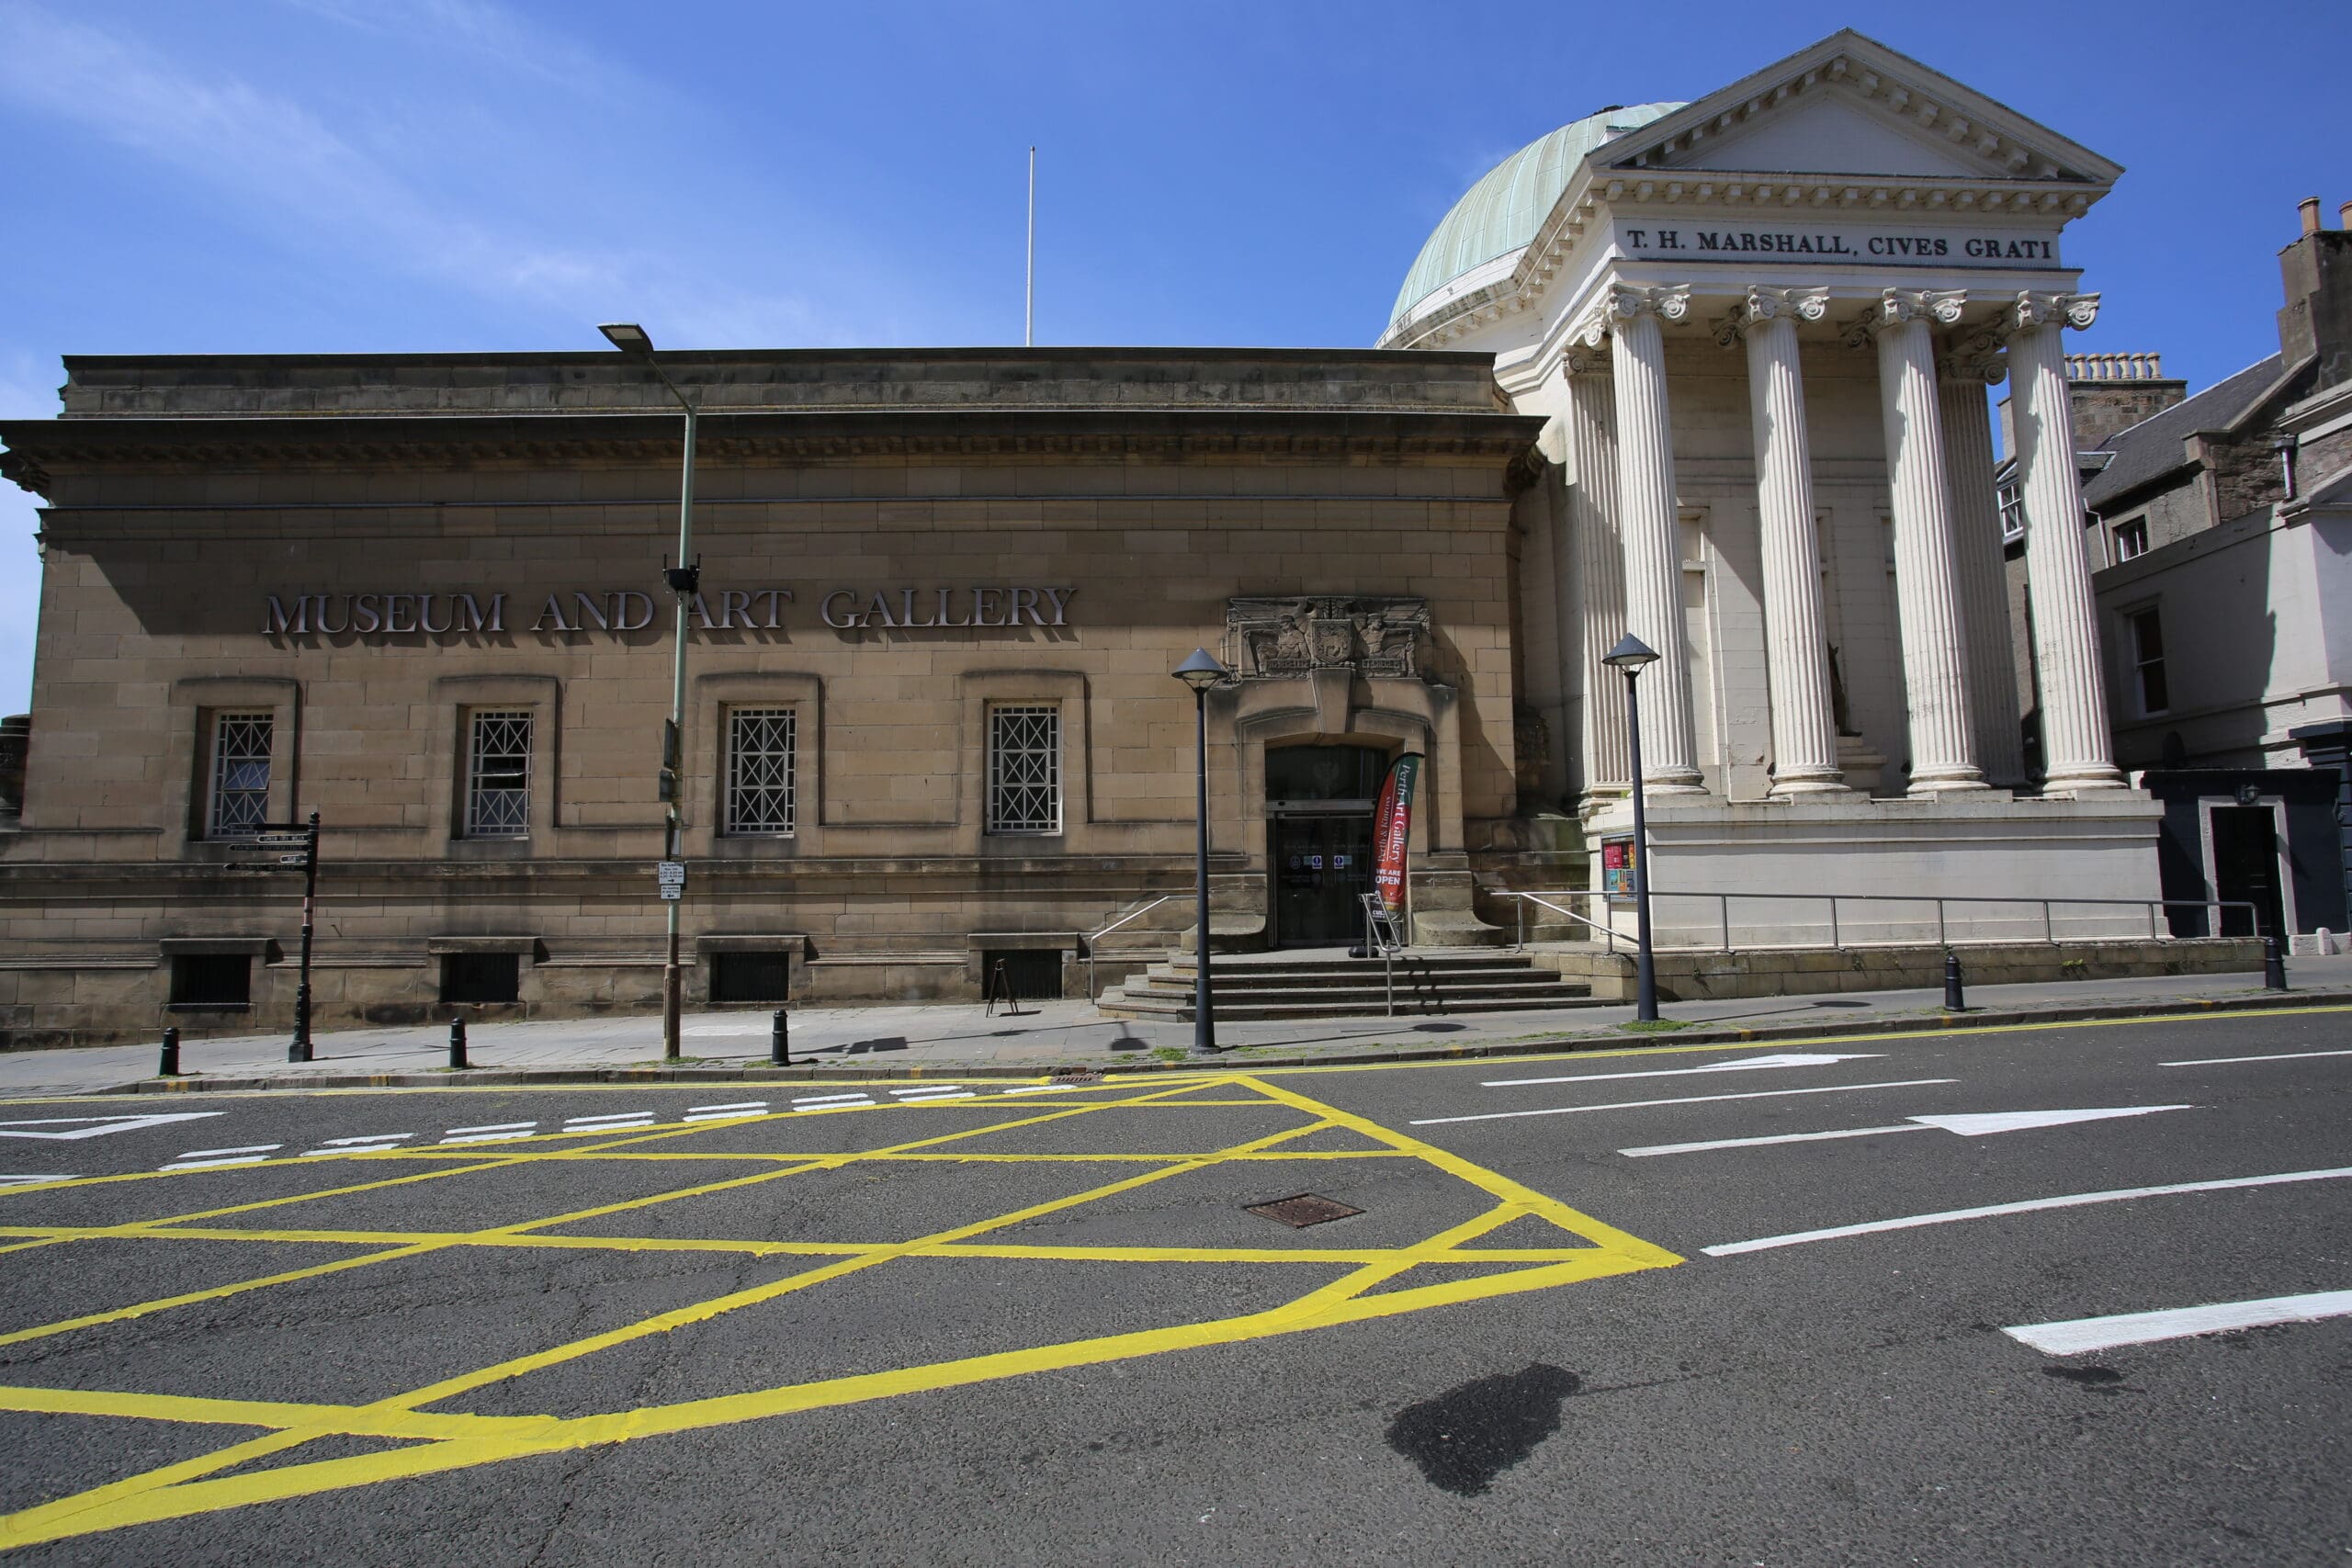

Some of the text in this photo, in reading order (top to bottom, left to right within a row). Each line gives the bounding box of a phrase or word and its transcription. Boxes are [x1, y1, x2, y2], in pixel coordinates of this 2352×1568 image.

[1626, 230, 2052, 259] T. H. MARSHALL, CIVES GRATI
[261, 587, 1079, 635] MUSEUM AND ART GALLERY
[1389, 764, 1410, 863] Perth Art Gallery
[1374, 874, 1401, 886] OPEN
